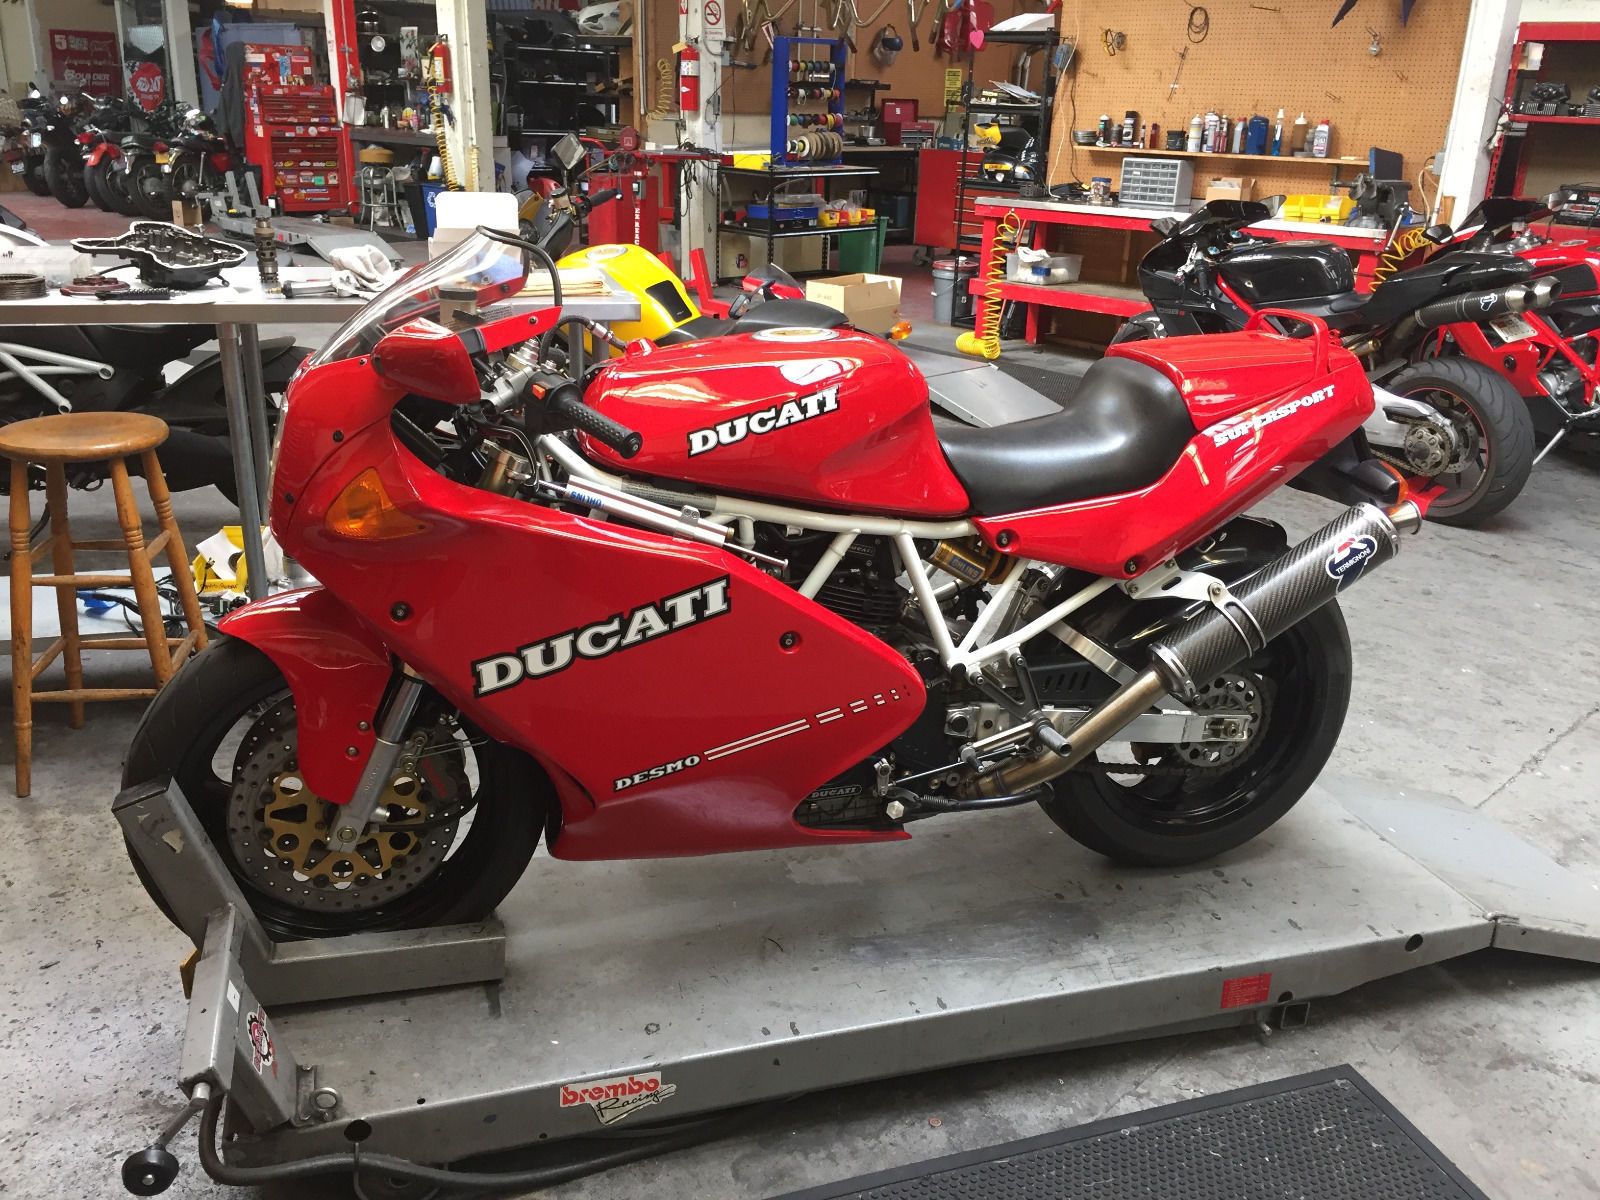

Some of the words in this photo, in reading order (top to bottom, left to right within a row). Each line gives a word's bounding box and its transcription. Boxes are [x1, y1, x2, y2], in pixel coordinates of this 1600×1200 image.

[689, 386, 839, 457] DUCATI
[1213, 384, 1335, 448] SUPERSPORT
[1335, 547, 1371, 574] TERMIGNONI
[475, 578, 728, 695] DUCATI
[614, 755, 700, 791] DESMO
[811, 787, 857, 799] DUCATI
[562, 1076, 660, 1105] brembo
[596, 1090, 661, 1118] Racing
